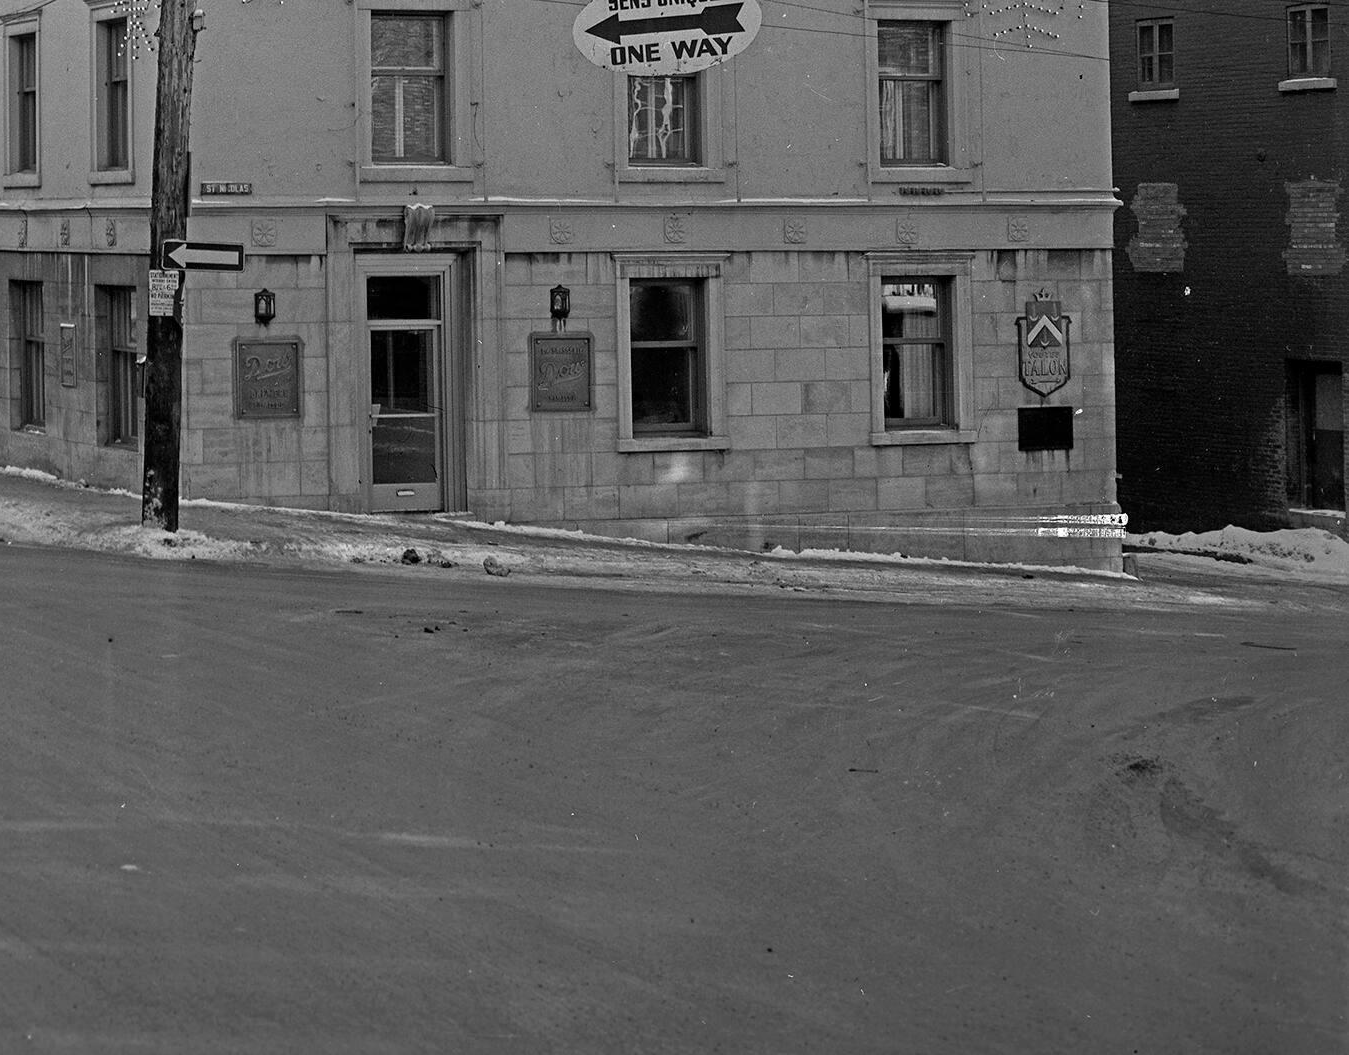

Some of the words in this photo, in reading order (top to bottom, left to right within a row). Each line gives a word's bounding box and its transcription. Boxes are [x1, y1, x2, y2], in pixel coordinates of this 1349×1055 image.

[610, 43, 661, 66] ONE
[671, 36, 733, 59] WAY
[206, 184, 216, 193] ST
[1023, 359, 1068, 376] TALON
